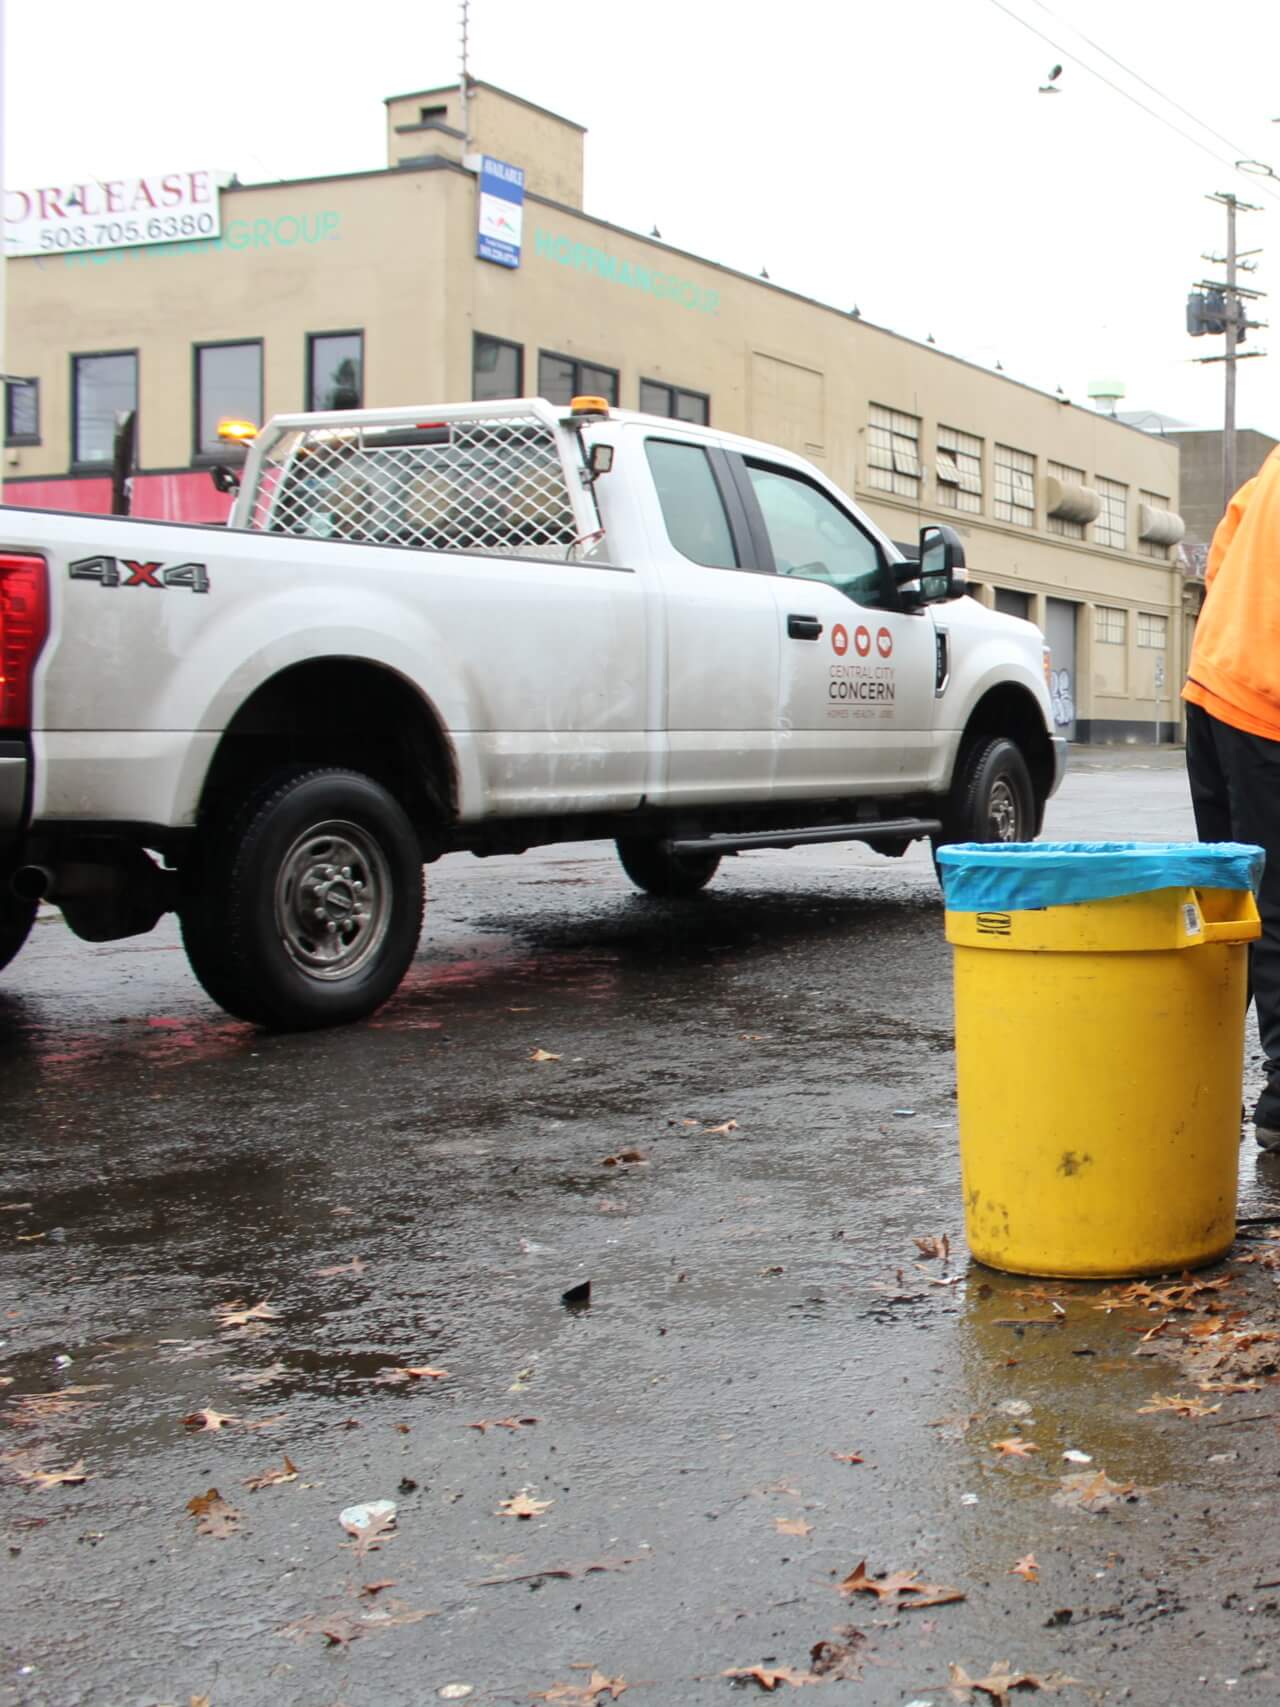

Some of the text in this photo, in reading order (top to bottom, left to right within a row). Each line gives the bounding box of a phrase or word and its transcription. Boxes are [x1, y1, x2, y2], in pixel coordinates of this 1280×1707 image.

[76, 171, 211, 216] LEASE
[40, 212, 214, 251] 503.705.6380
[830, 664, 894, 680] CENTRAL CITY
[829, 681, 895, 700] CONCERN
